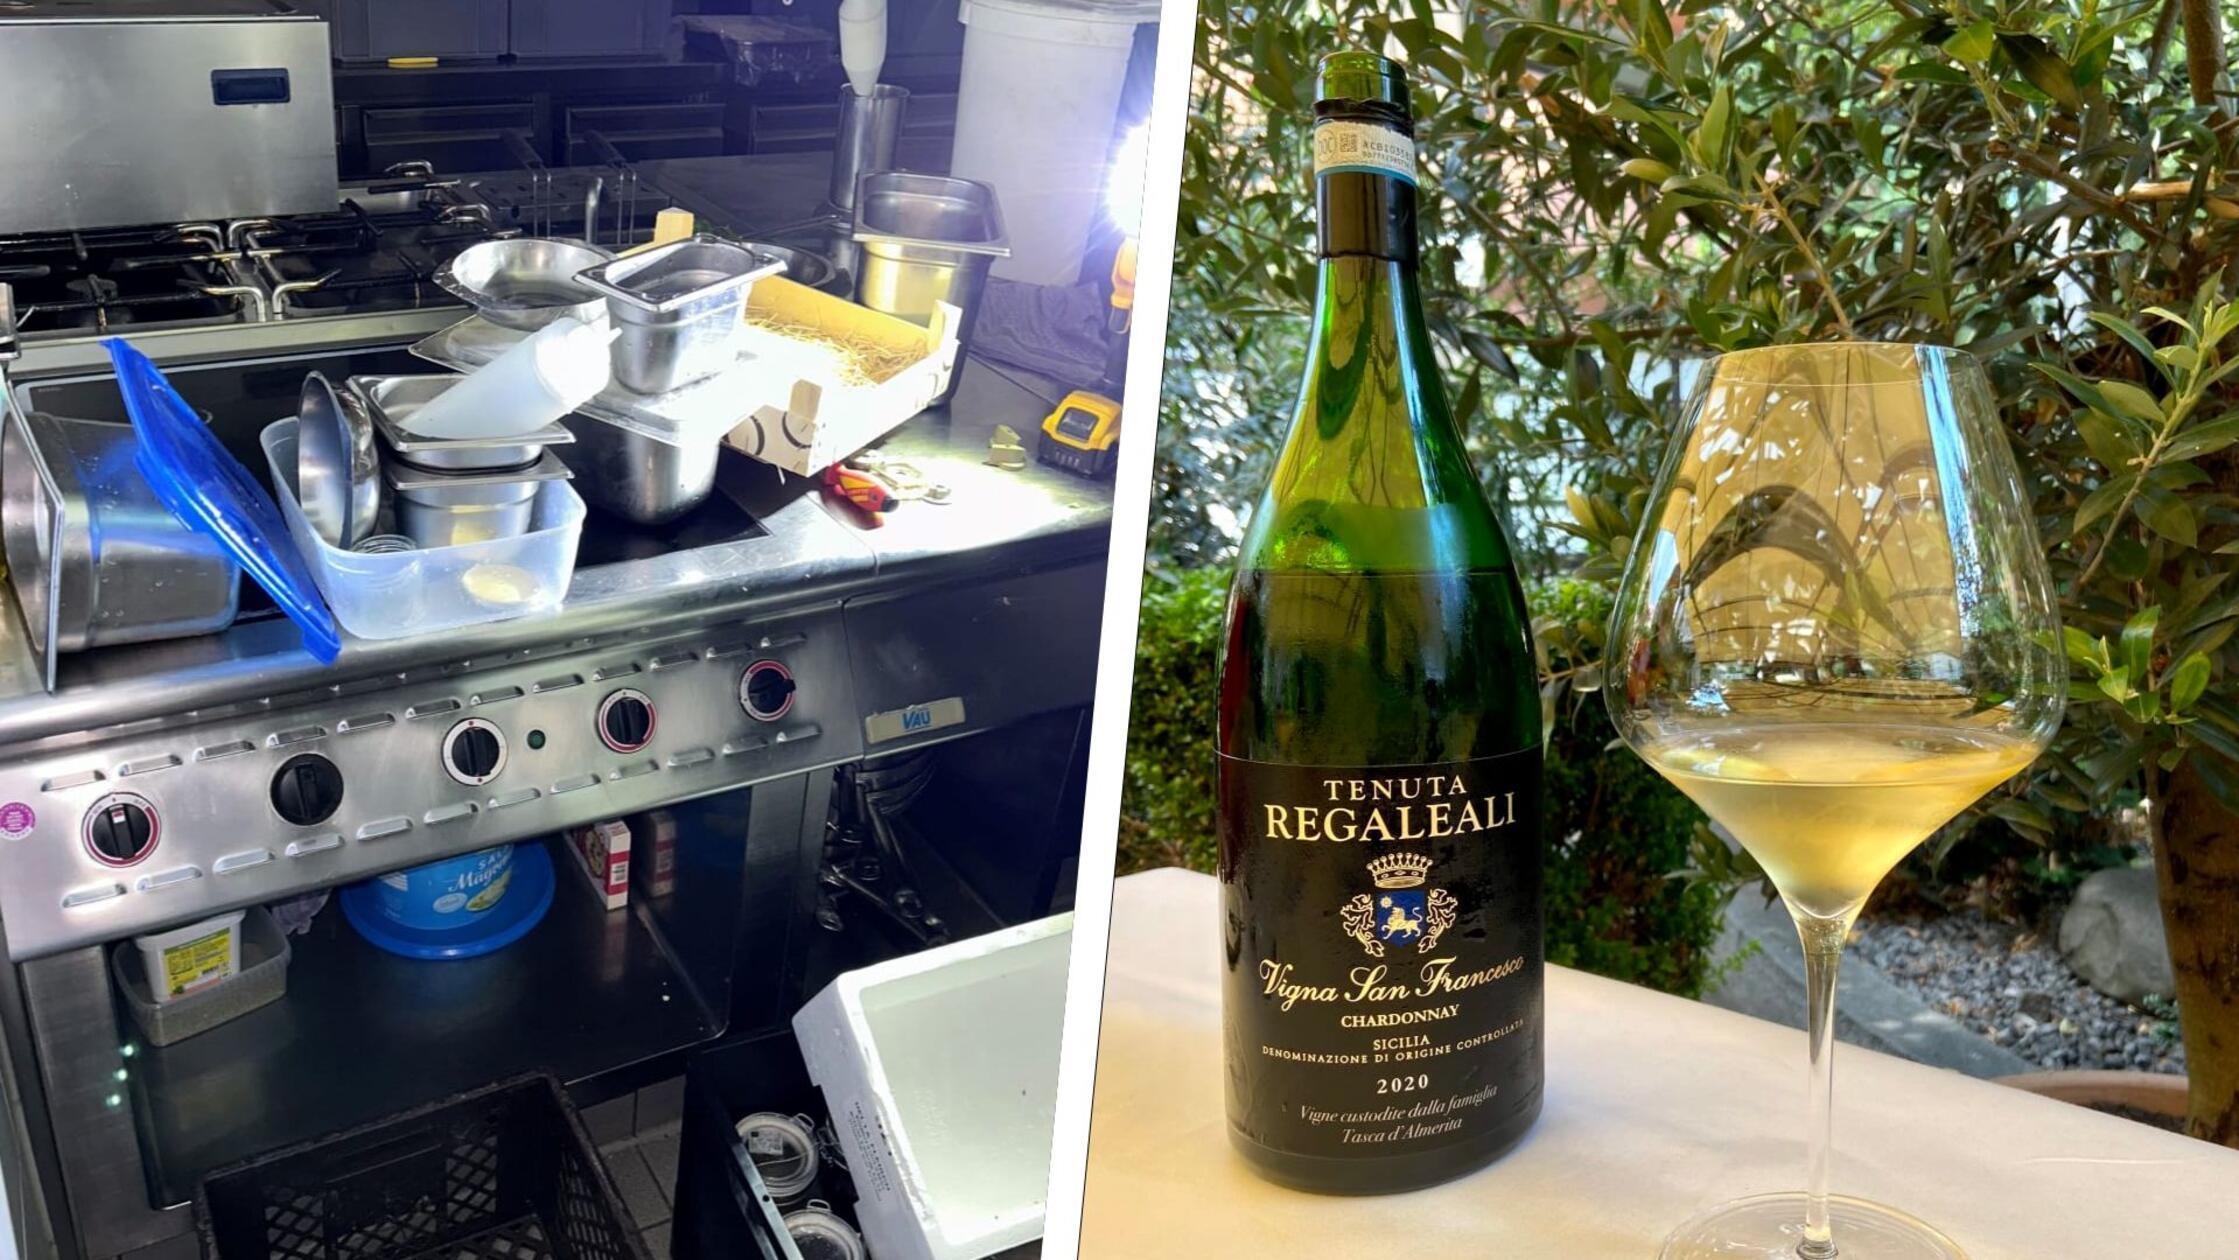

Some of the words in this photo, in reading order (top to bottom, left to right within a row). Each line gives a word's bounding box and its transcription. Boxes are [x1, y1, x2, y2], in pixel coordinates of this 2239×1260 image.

[903, 709, 931, 730] VAU
[1323, 774, 1468, 801] TENUTA
[1263, 791, 1516, 842] REGALEALI
[1259, 958, 1339, 1012] Vigna
[1343, 964, 1410, 1002] San
[1415, 955, 1525, 998] Francesco
[1340, 1003, 1460, 1028] CHARDONNAY
[1262, 1045, 1369, 1064] DENOMINAZIONE
[1374, 1053, 1389, 1063] DI
[1395, 1044, 1451, 1062] ORIGINE
[1456, 1018, 1524, 1051] CONTROLLATA
[1372, 1034, 1431, 1052] SICILIA
[1376, 1073, 1429, 1094] 2020
[1300, 1104, 1339, 1126] Vigne
[1340, 1106, 1406, 1122] custodite
[1407, 1099, 1446, 1119] dalla
[1442, 1084, 1499, 1117] famiglia
[1342, 1128, 1386, 1144] Tasca
